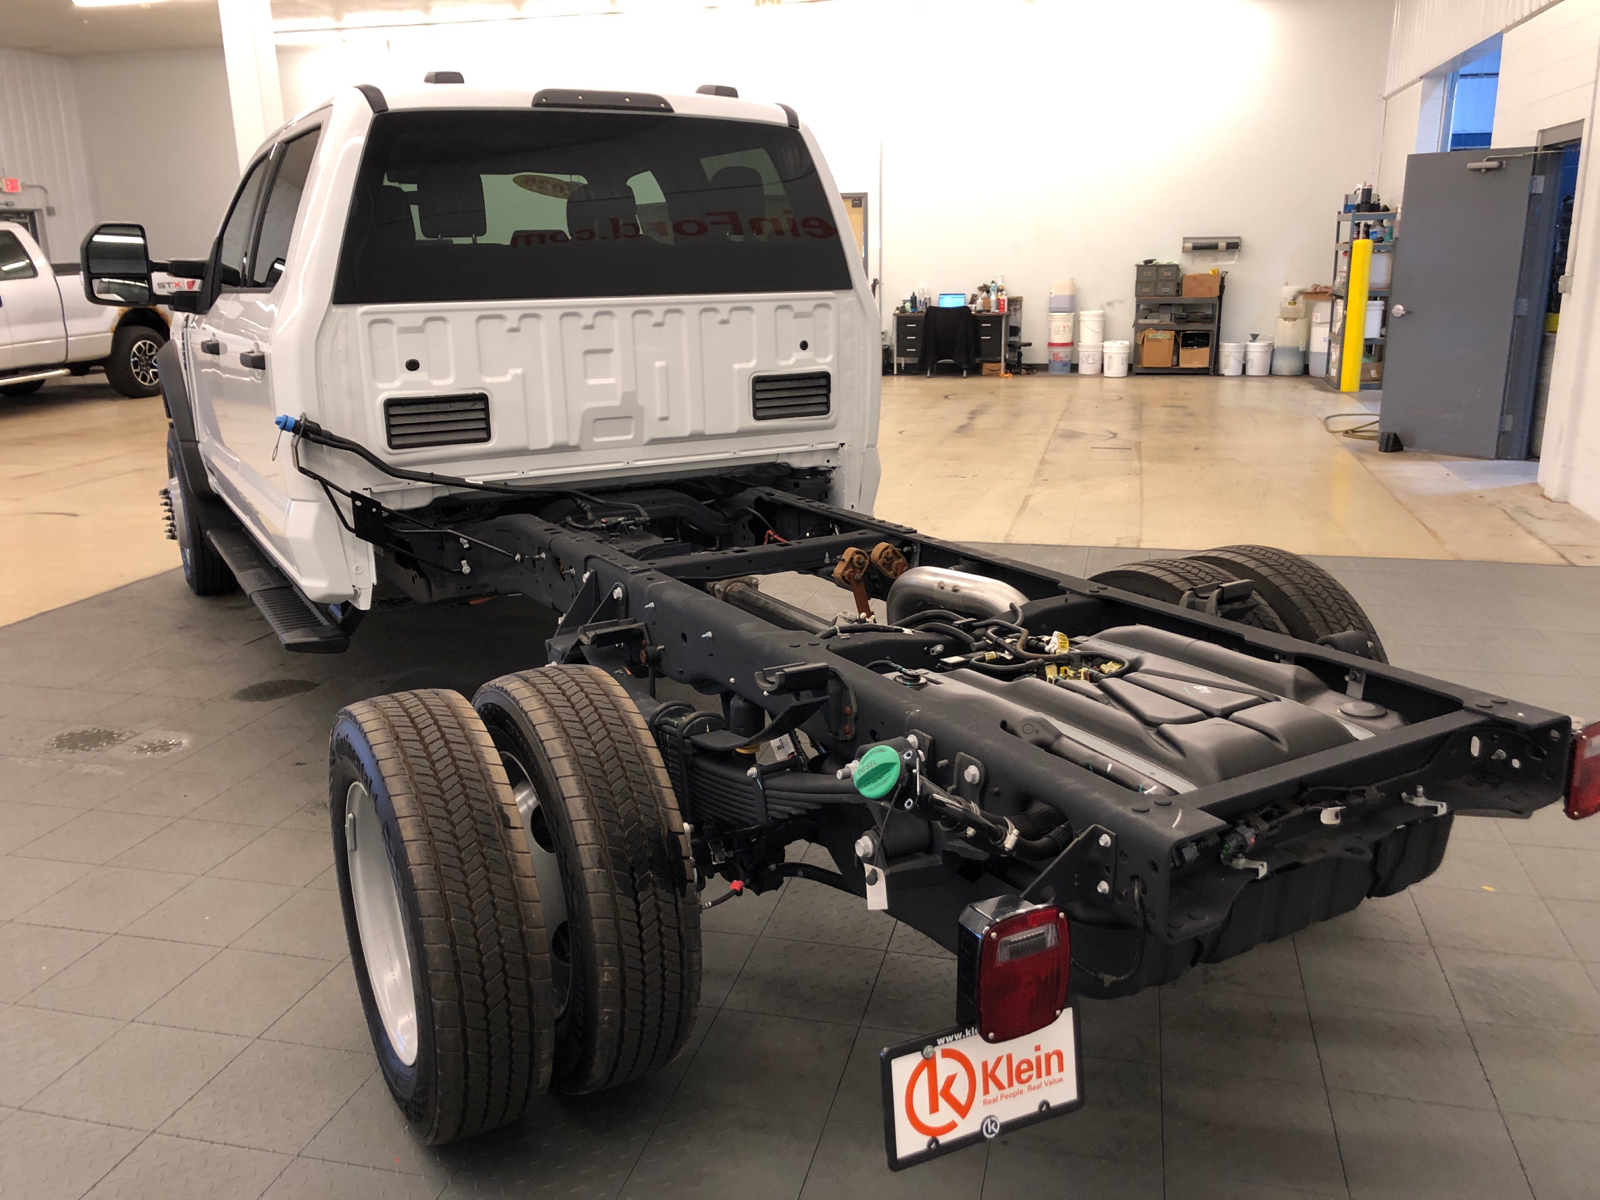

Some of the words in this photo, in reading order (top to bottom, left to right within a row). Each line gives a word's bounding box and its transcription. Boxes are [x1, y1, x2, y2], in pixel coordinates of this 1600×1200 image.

[157, 281, 181, 289] STX
[857, 759, 877, 776] DIESEL
[981, 1044, 1065, 1096] Klein
[983, 1095, 998, 1107] Real
[1000, 1088, 1026, 1102] People.
[1027, 1082, 1042, 1093] Real
[1044, 1076, 1065, 1087] Value.
